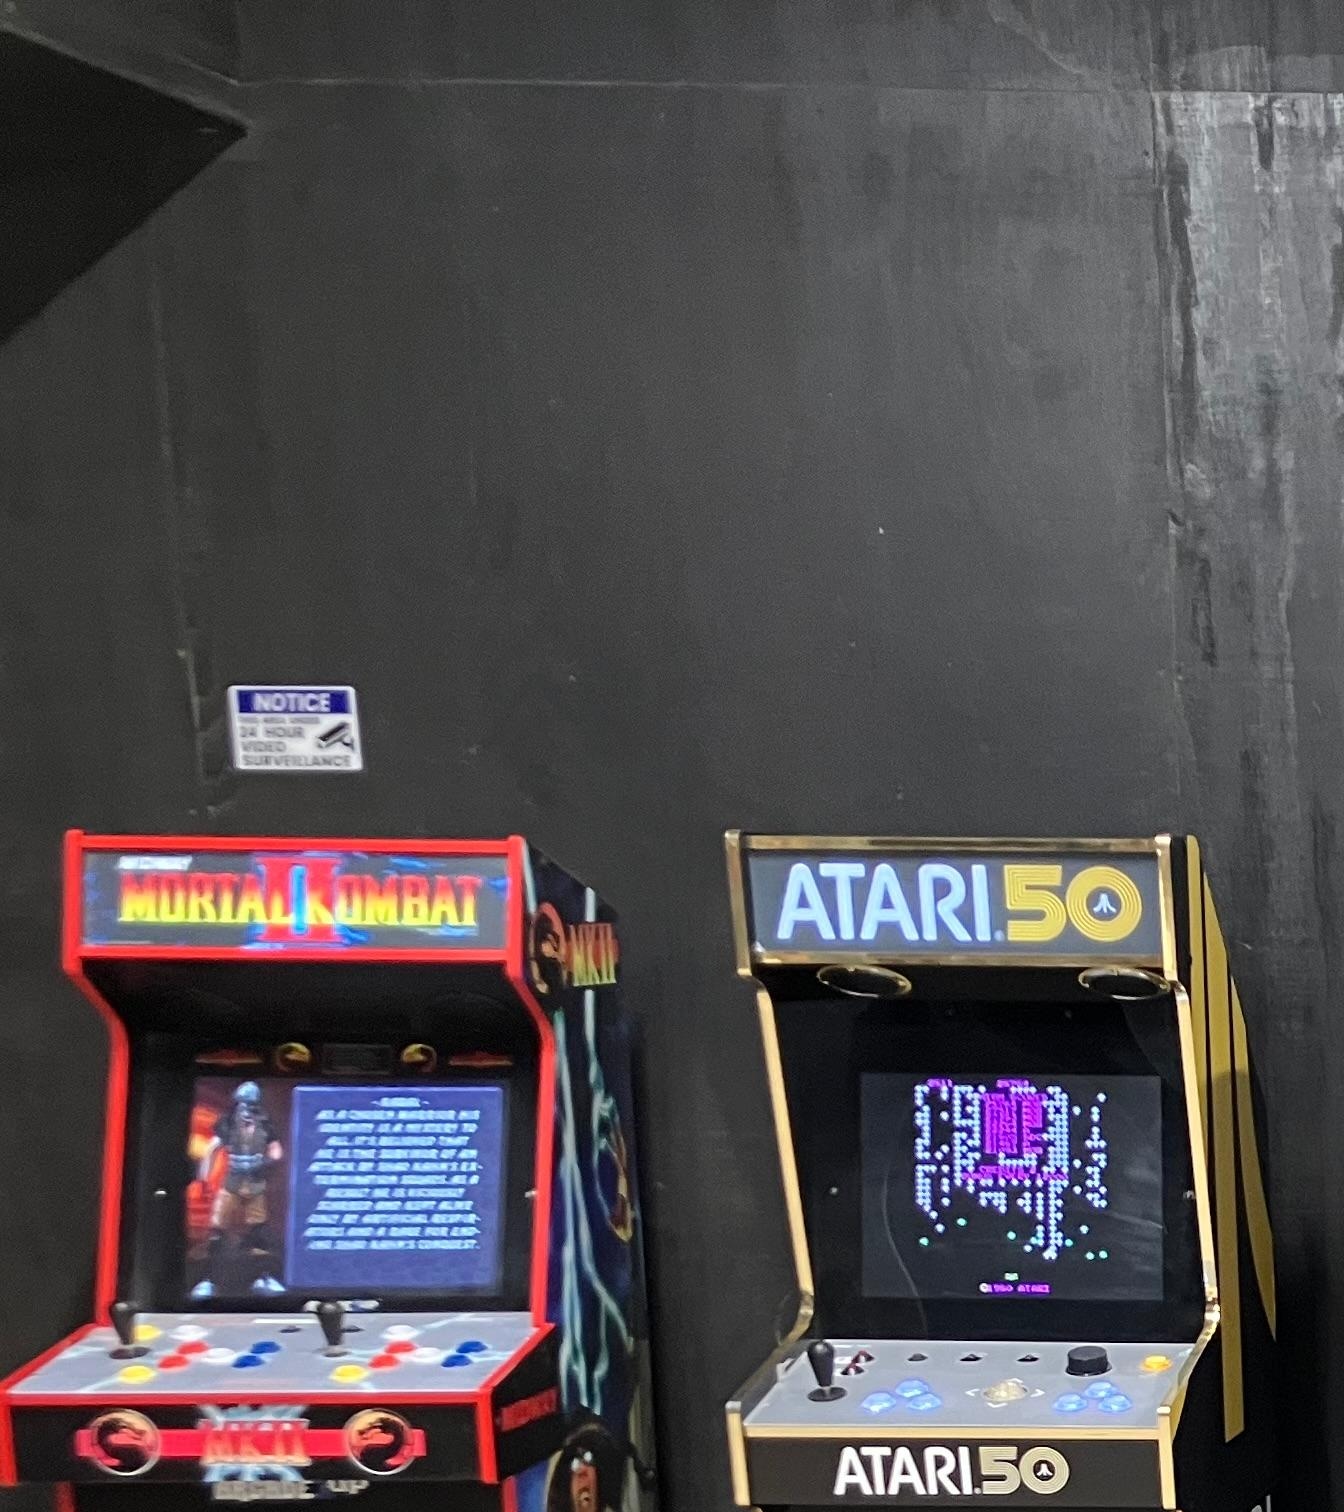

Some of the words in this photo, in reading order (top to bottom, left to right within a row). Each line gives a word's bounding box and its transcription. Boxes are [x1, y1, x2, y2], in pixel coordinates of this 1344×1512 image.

[253, 692, 331, 713] NOTICE
[263, 726, 304, 738] HOUR
[242, 741, 287, 752] VIDEO
[242, 755, 351, 767] SURVEILLANCE
[117, 871, 295, 924] MORTAL
[302, 873, 483, 927] KOMBAT
